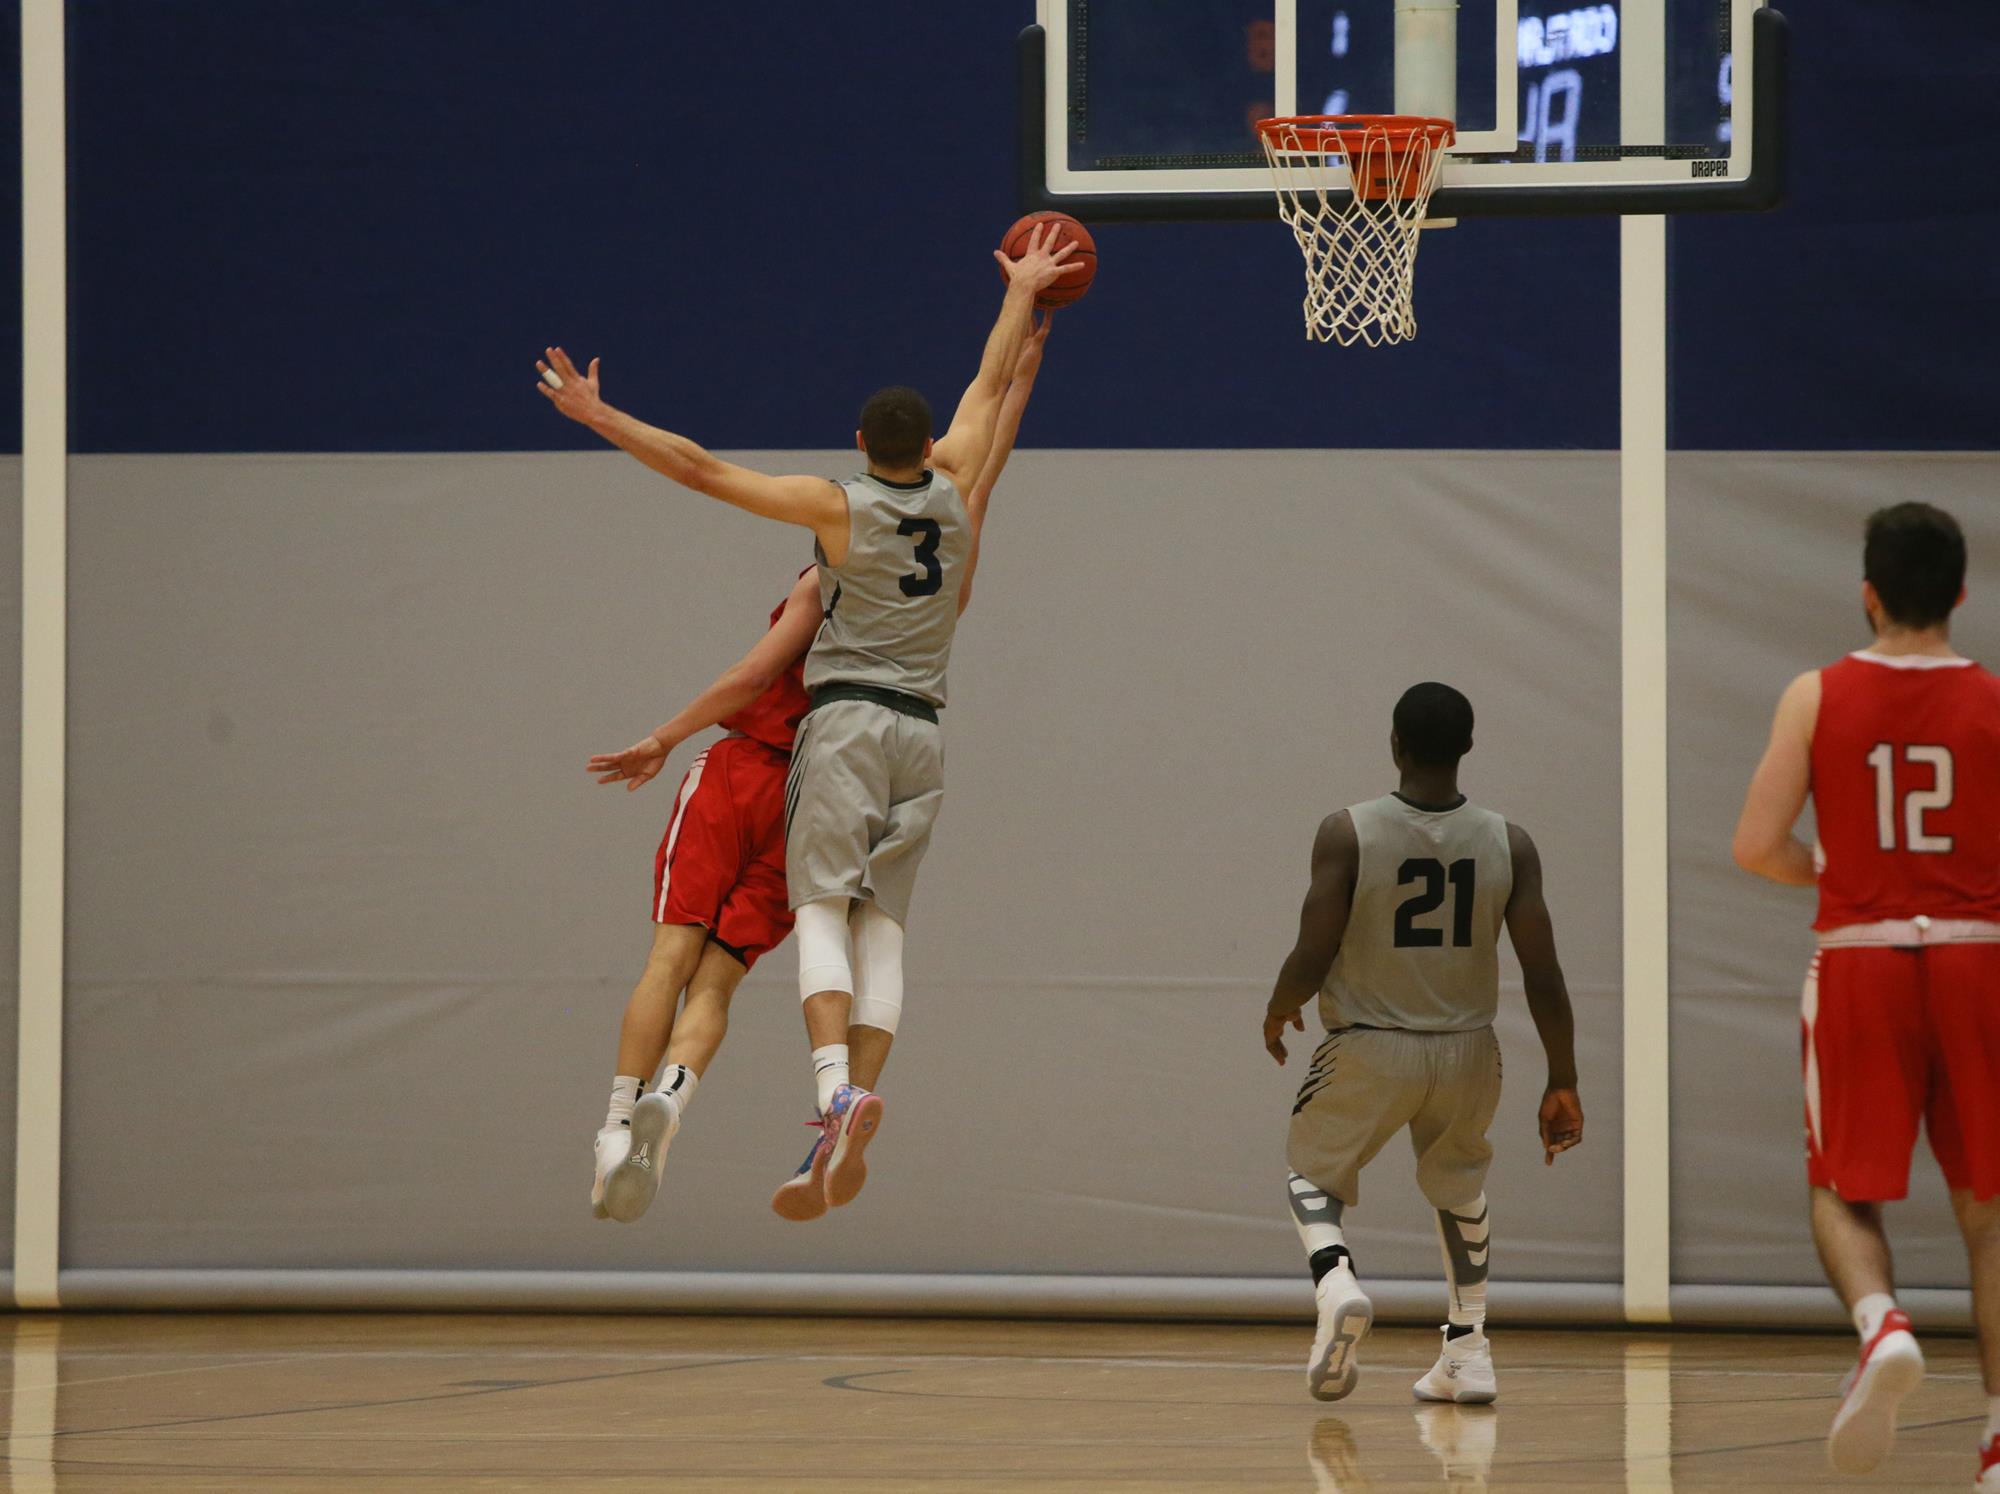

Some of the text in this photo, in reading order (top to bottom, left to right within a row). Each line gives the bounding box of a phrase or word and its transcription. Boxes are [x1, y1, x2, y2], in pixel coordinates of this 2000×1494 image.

[896, 518, 943, 598] 3
[1866, 742, 1954, 853] 12
[1393, 857, 1476, 948] 21
